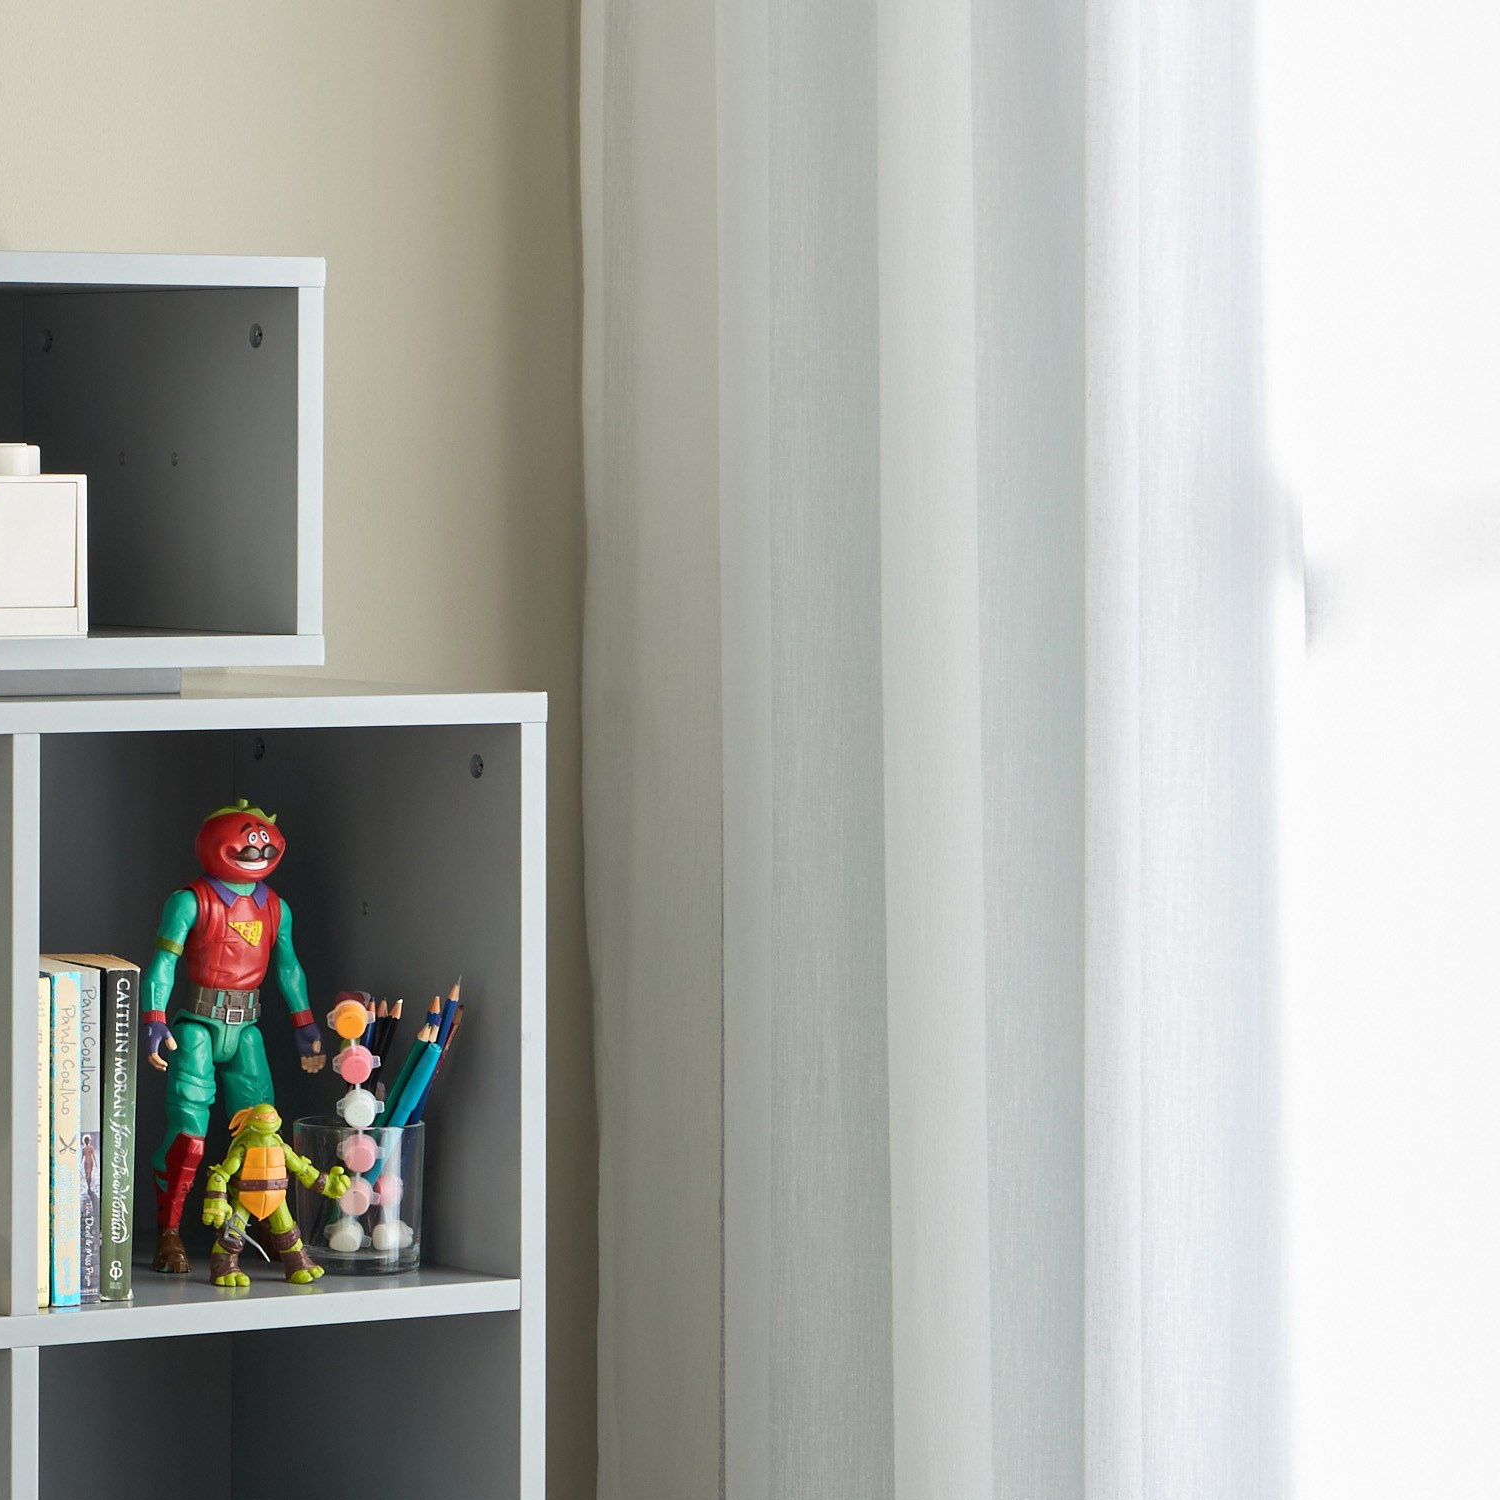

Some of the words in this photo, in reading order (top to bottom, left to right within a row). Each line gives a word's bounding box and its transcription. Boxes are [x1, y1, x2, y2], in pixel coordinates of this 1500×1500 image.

[61, 1005, 76, 1053] Paulo
[81, 986, 97, 1033] Paulo
[115, 977, 131, 1053] CAITLIN
[60, 1060, 76, 1115] Coelho
[80, 1038, 96, 1093] Coelho
[113, 1057, 128, 1118] MORAN
[110, 1118, 131, 1149] How
[111, 1185, 130, 1244] Woman
[85, 1249, 94, 1267] Miss
